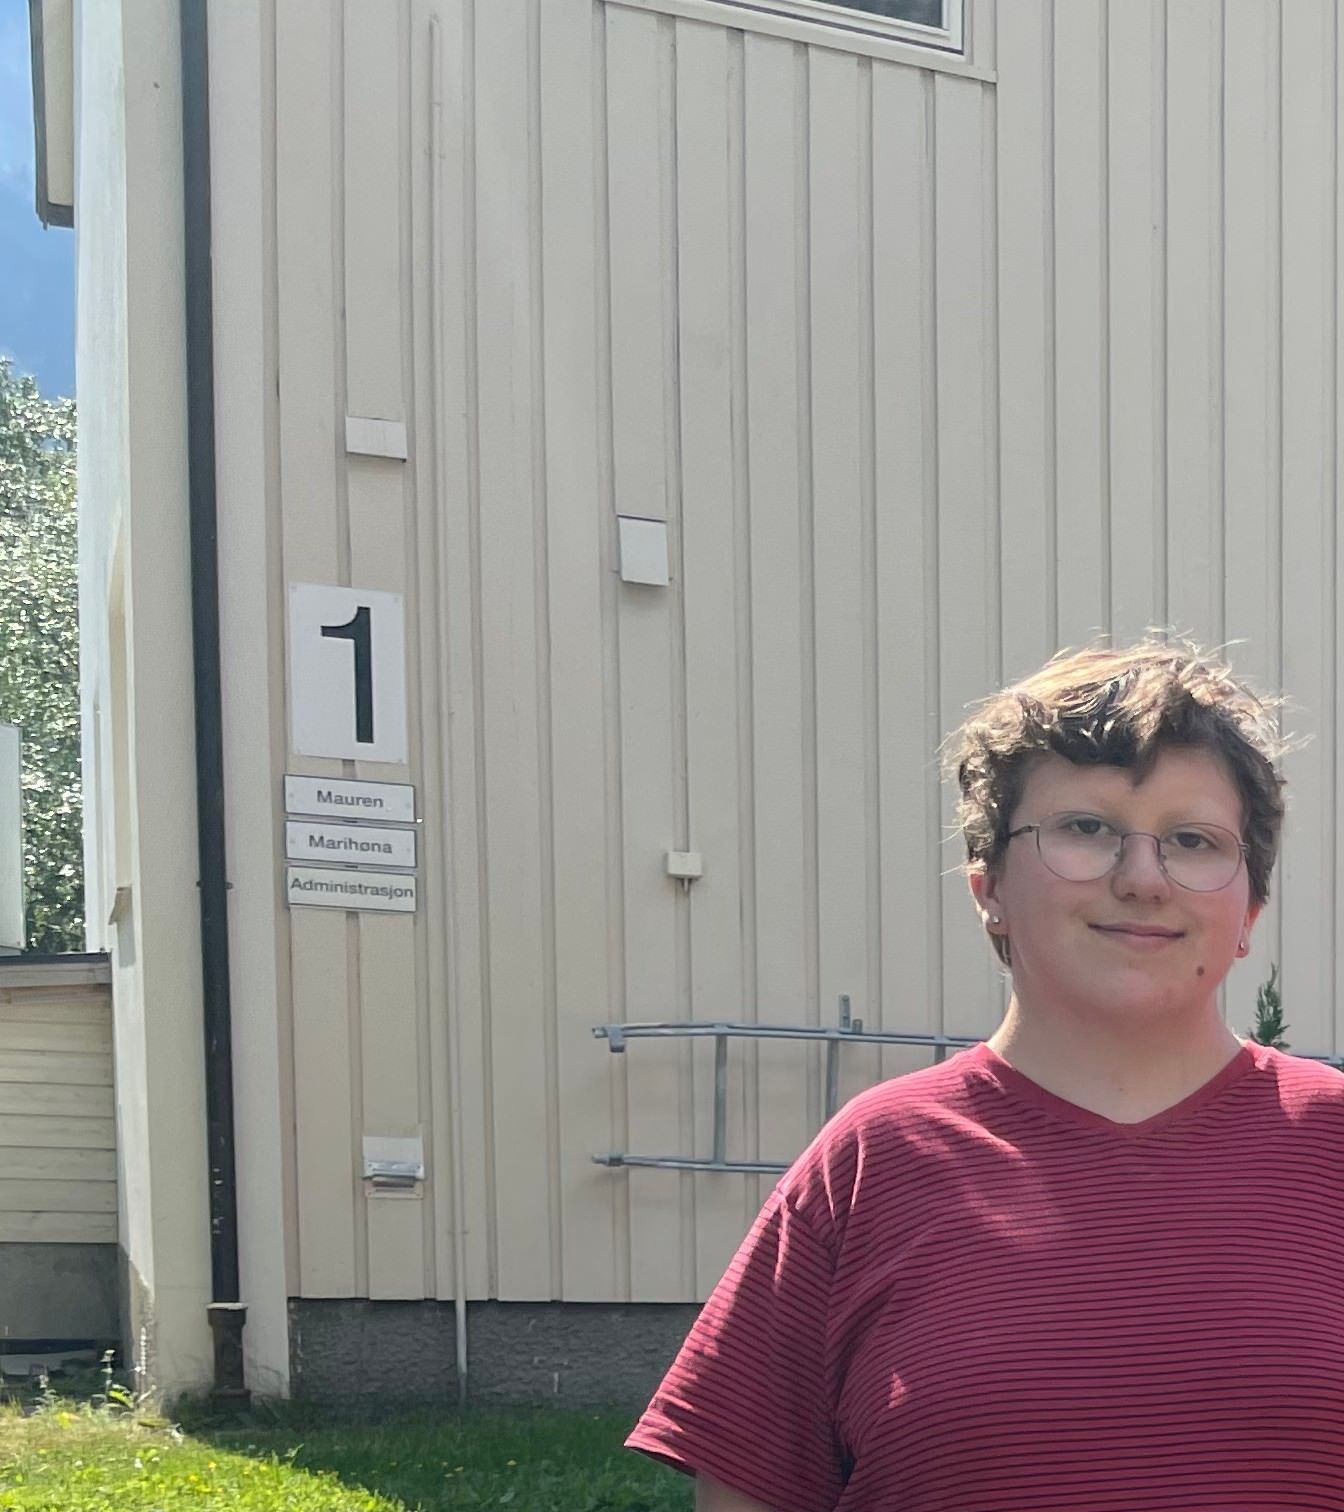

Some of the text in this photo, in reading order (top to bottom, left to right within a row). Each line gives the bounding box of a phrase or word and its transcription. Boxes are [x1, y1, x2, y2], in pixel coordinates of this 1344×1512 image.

[320, 606, 374, 743] 1
[316, 790, 384, 808] Mauren
[290, 878, 414, 900] Administrasjon
